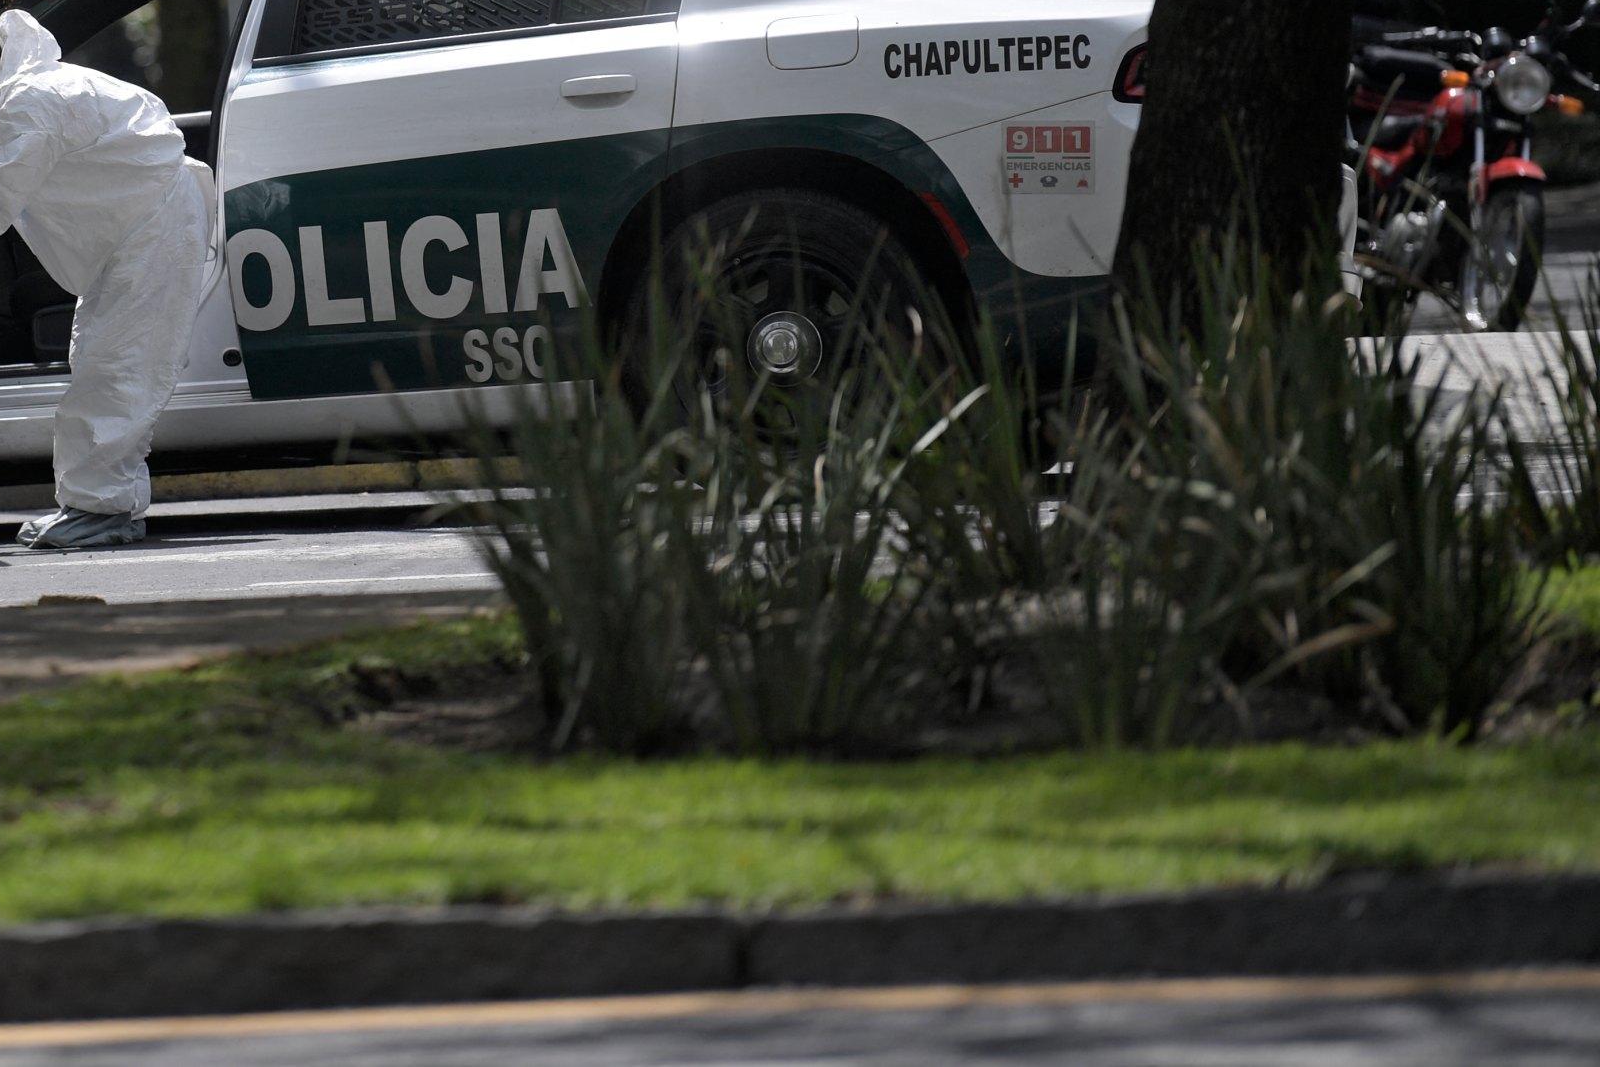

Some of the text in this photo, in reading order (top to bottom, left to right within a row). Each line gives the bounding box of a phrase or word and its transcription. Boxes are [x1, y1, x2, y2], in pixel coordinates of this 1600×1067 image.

[884, 34, 1092, 79] CHAPULTEPEC
[1011, 130, 1082, 150] 911
[1006, 161, 1092, 171] EMERGENCIAS
[227, 208, 592, 332] OLICIA
